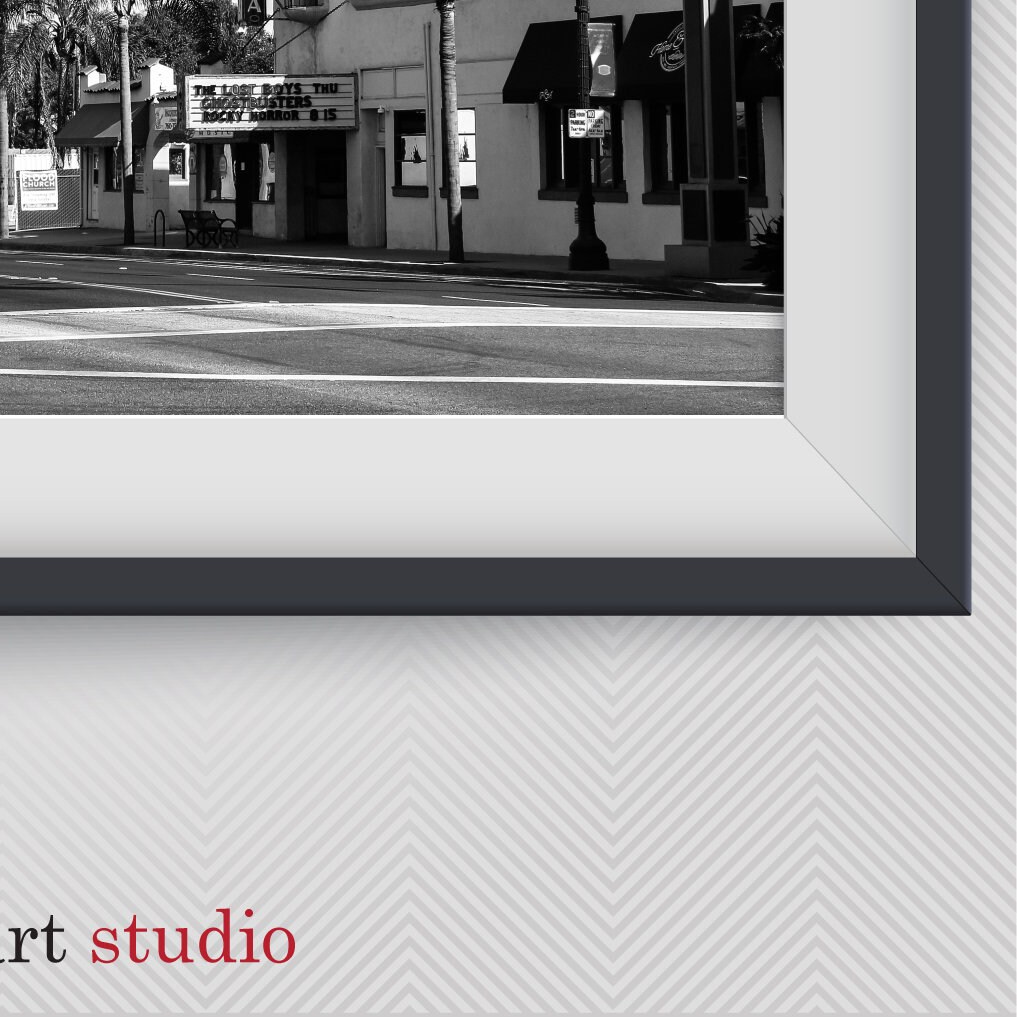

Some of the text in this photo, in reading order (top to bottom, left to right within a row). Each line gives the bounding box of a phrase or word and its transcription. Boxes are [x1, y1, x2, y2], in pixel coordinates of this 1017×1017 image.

[194, 83, 339, 96] THE LOST BOYS THU
[200, 95, 313, 110] GHOSTBUSTERS
[202, 111, 245, 123] ROCKY
[249, 109, 300, 123] HORROR
